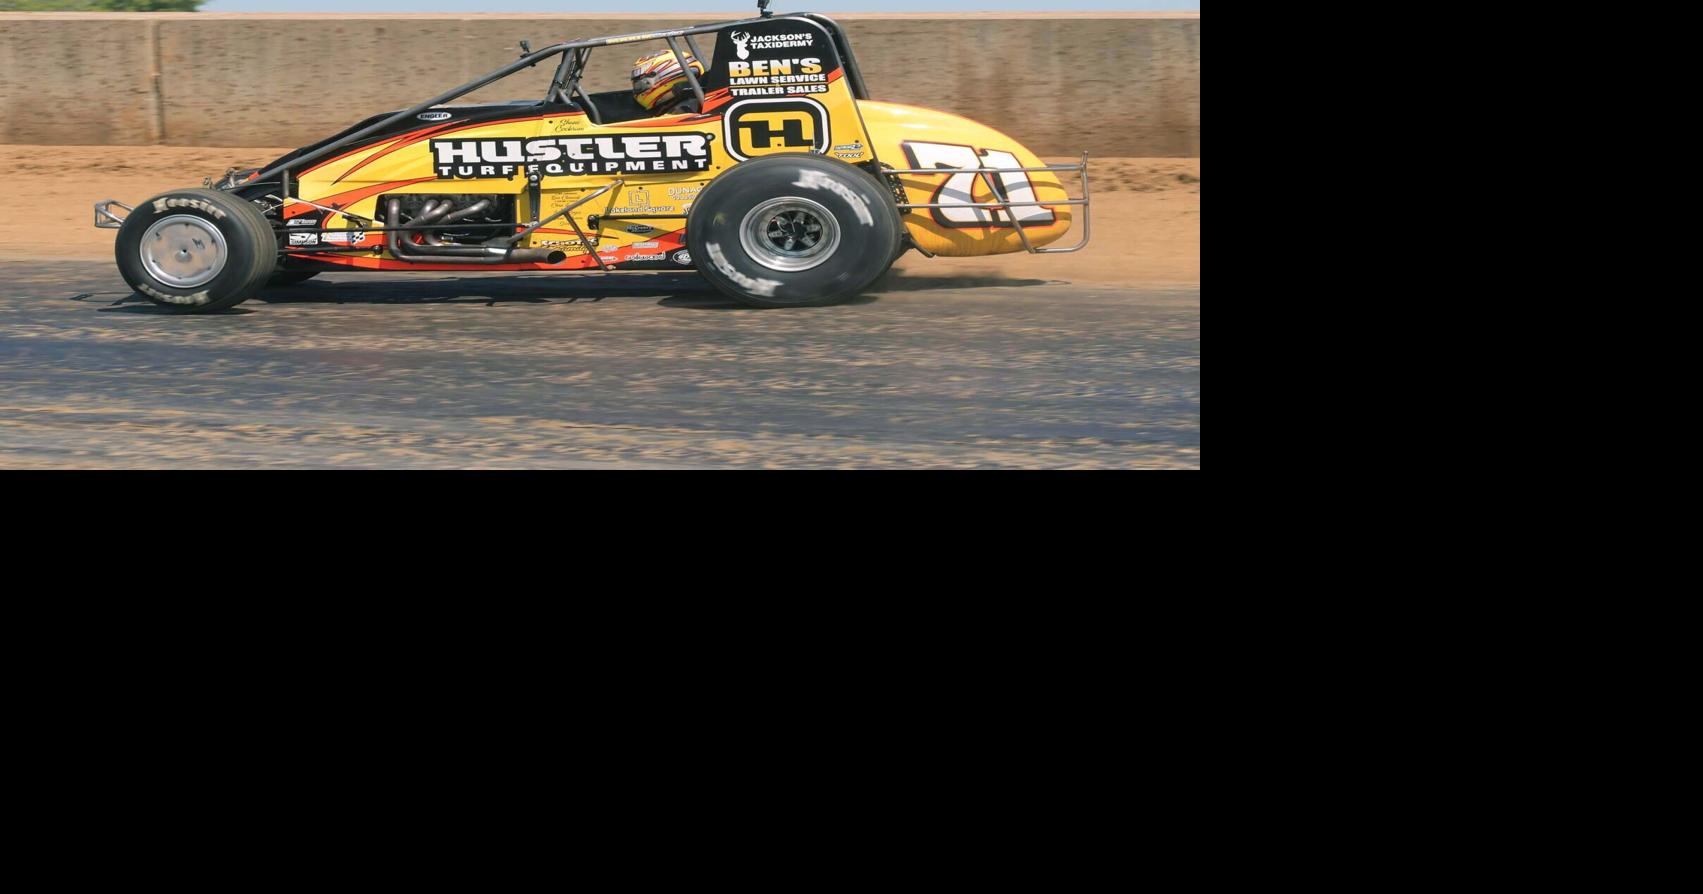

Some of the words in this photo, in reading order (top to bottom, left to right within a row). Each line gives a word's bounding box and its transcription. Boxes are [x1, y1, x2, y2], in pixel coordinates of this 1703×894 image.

[750, 33, 812, 43] JACKSON'S
[750, 40, 813, 49] TAXIDERMY
[728, 57, 822, 77] BEN'S
[730, 77, 768, 85] LAWN
[770, 74, 826, 83] SERVICE
[732, 87, 784, 96] TRAILER
[786, 85, 827, 94] SALES
[434, 135, 706, 164] HUSTLER
[438, 165, 514, 176] TURF
[527, 158, 706, 173] EQUIPMENT
[900, 140, 1056, 228] 71
